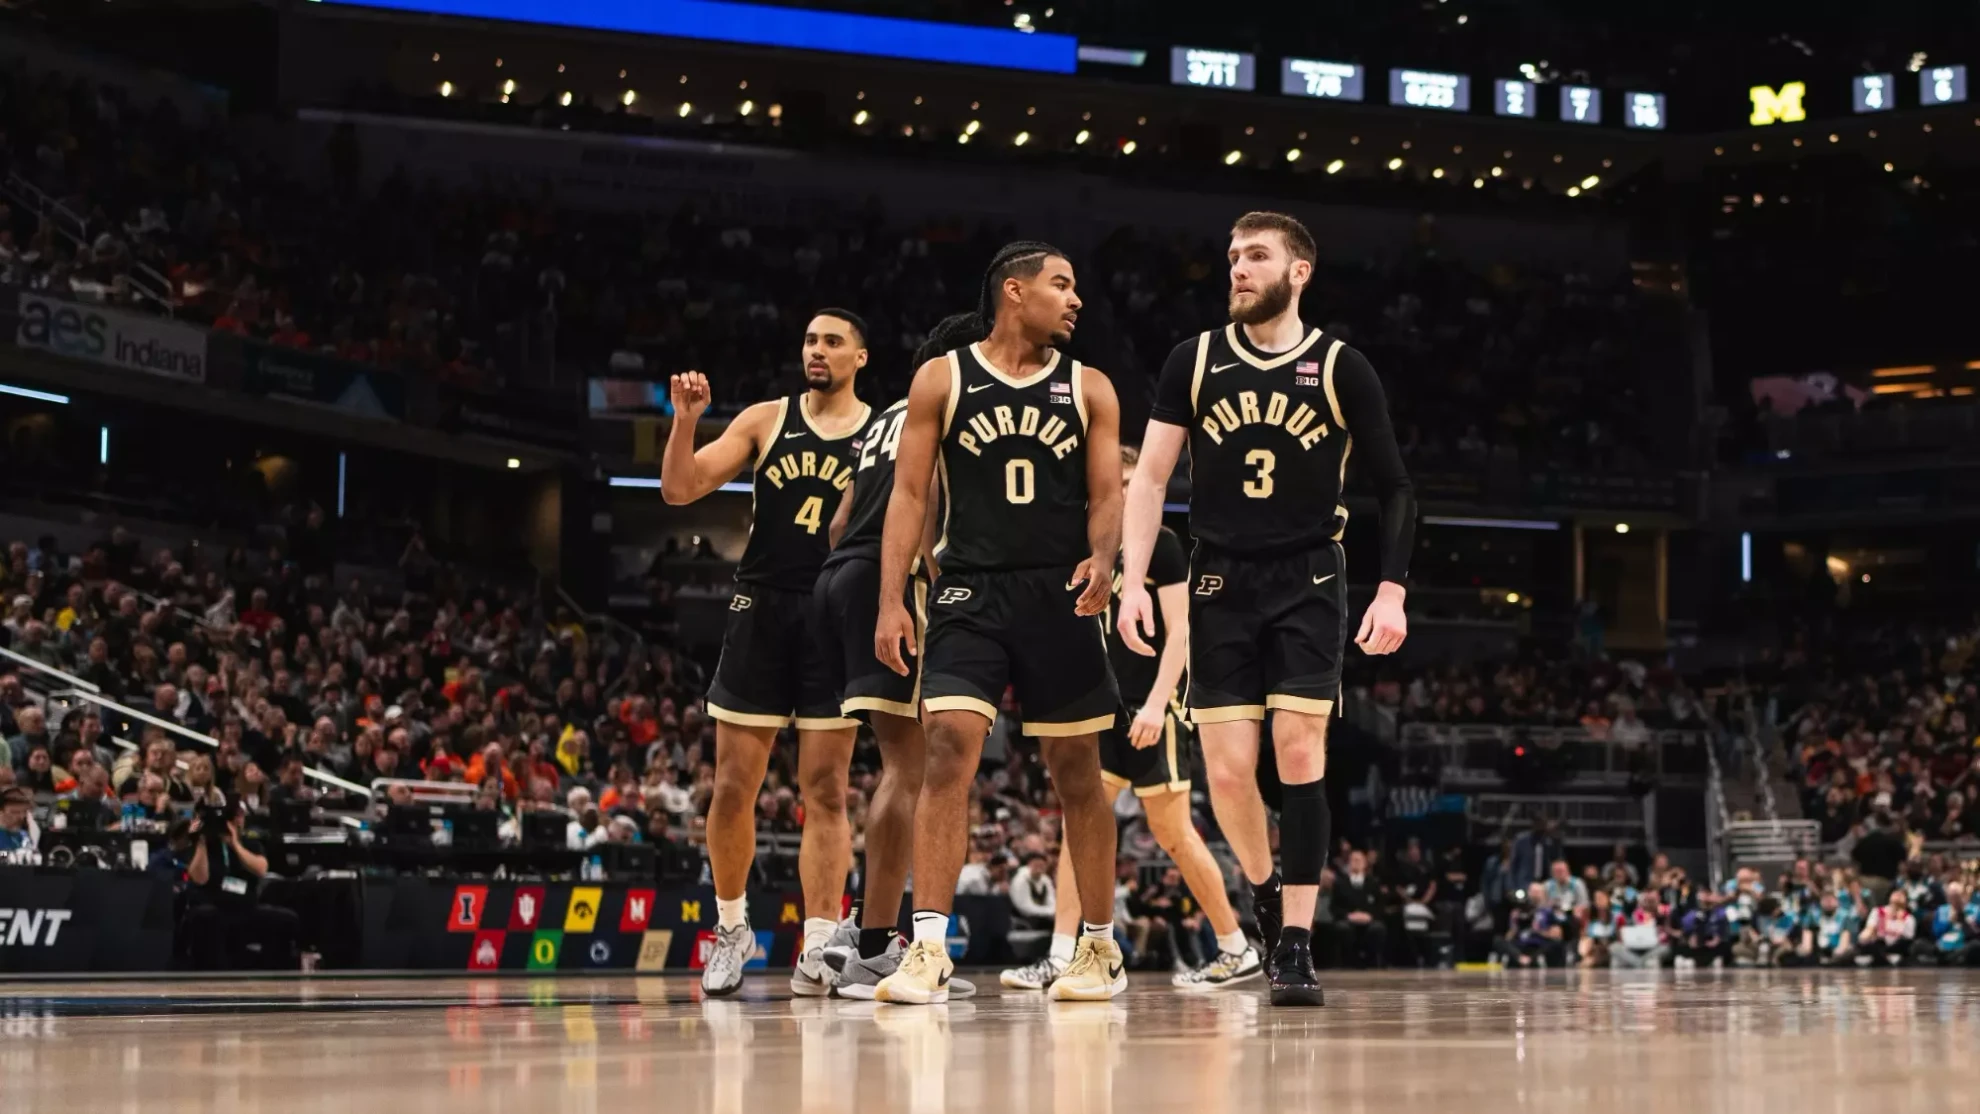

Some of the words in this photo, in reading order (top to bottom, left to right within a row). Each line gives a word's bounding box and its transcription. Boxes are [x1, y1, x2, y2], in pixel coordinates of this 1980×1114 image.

[1506, 94, 1523, 114] 2
[1572, 100, 1589, 120] 7
[1750, 81, 1806, 126] M
[22, 301, 108, 356] aes
[115, 330, 201, 377] Indiana
[858, 409, 908, 472] 24
[958, 405, 1078, 460] PURDUE
[1202, 390, 1329, 451] PURDUE
[765, 451, 853, 491] PURDU
[1005, 459, 1034, 504] 0
[1243, 449, 1276, 499] 3
[794, 495, 823, 535] 4
[730, 594, 752, 612] P
[937, 587, 972, 604] P
[1195, 575, 1223, 595] P
[459, 892, 475, 925] I
[681, 900, 701, 923] M
[535, 939, 555, 964] O
